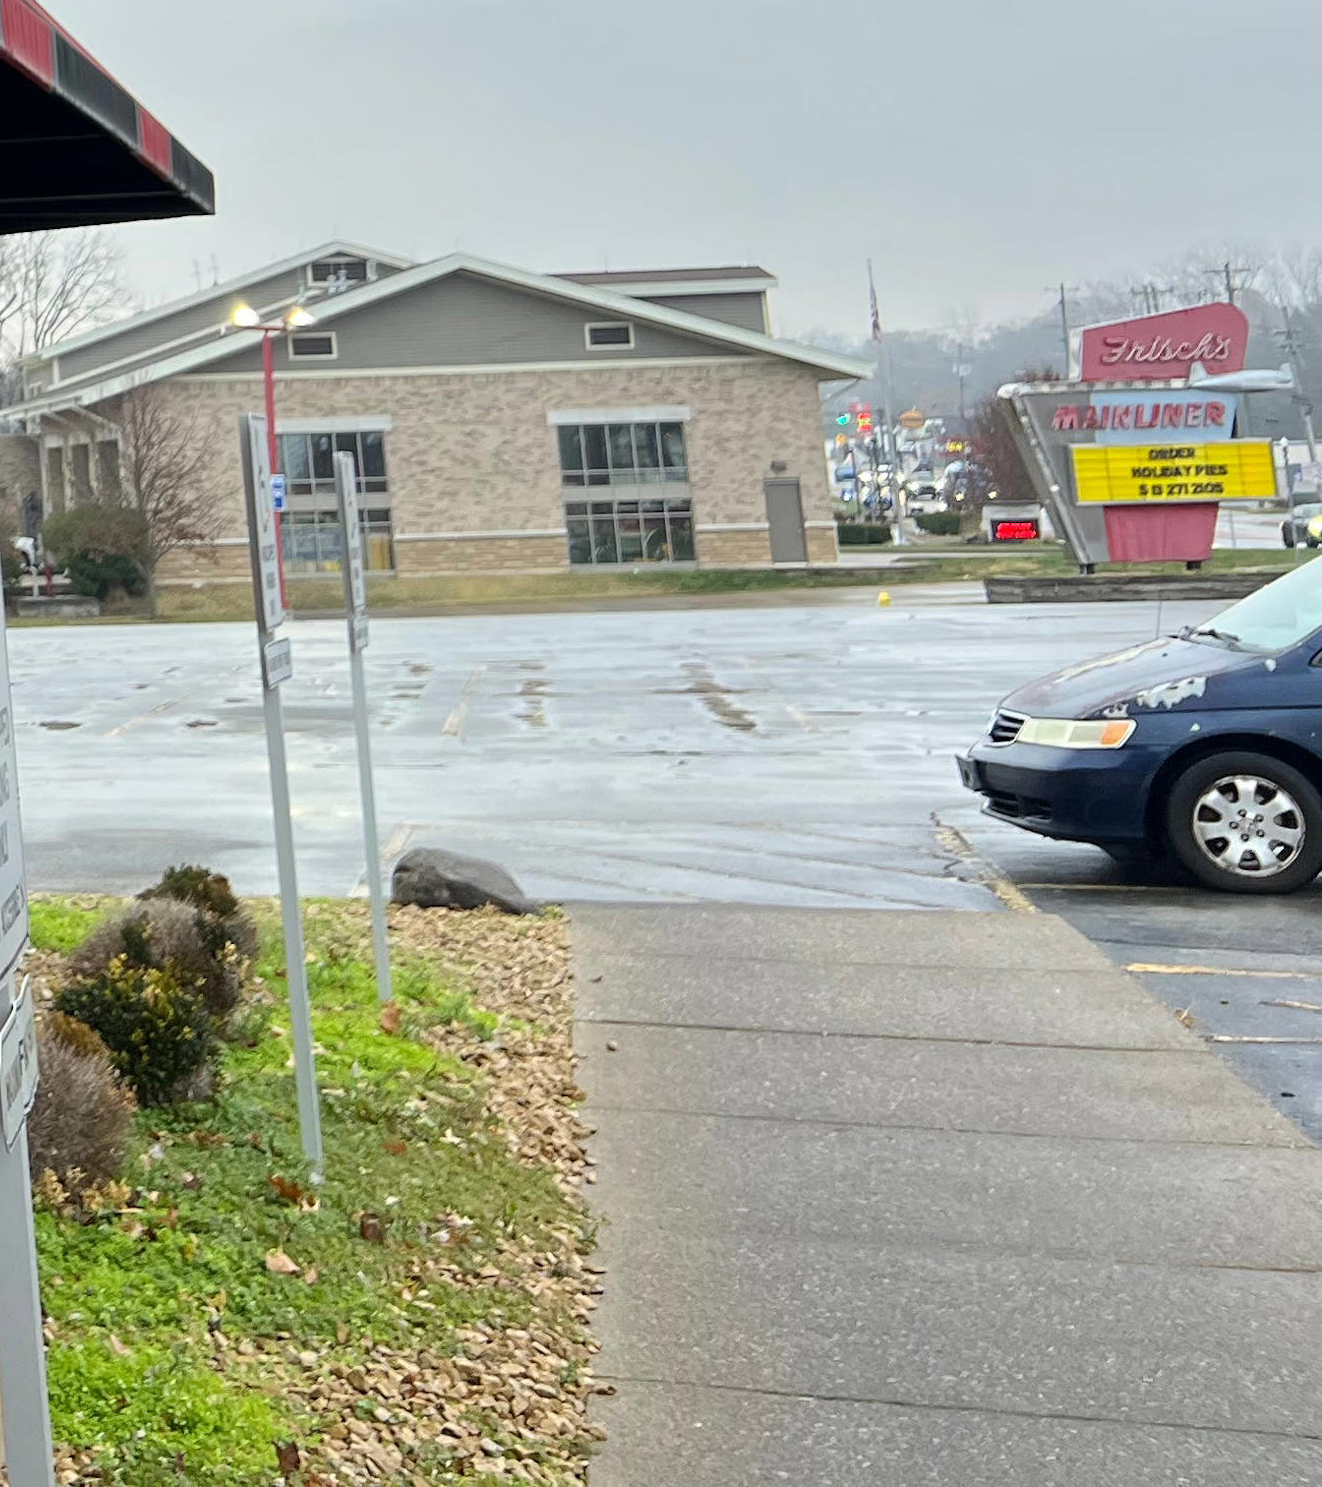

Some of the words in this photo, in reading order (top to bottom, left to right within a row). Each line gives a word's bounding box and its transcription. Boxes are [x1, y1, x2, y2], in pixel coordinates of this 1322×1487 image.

[1101, 332, 1231, 364] Frisch's
[1051, 401, 1227, 430] MAINLINER
[1149, 448, 1195, 460] ORDER
[1132, 465, 1191, 478] HOLIDAY
[1195, 464, 1228, 476] PIES
